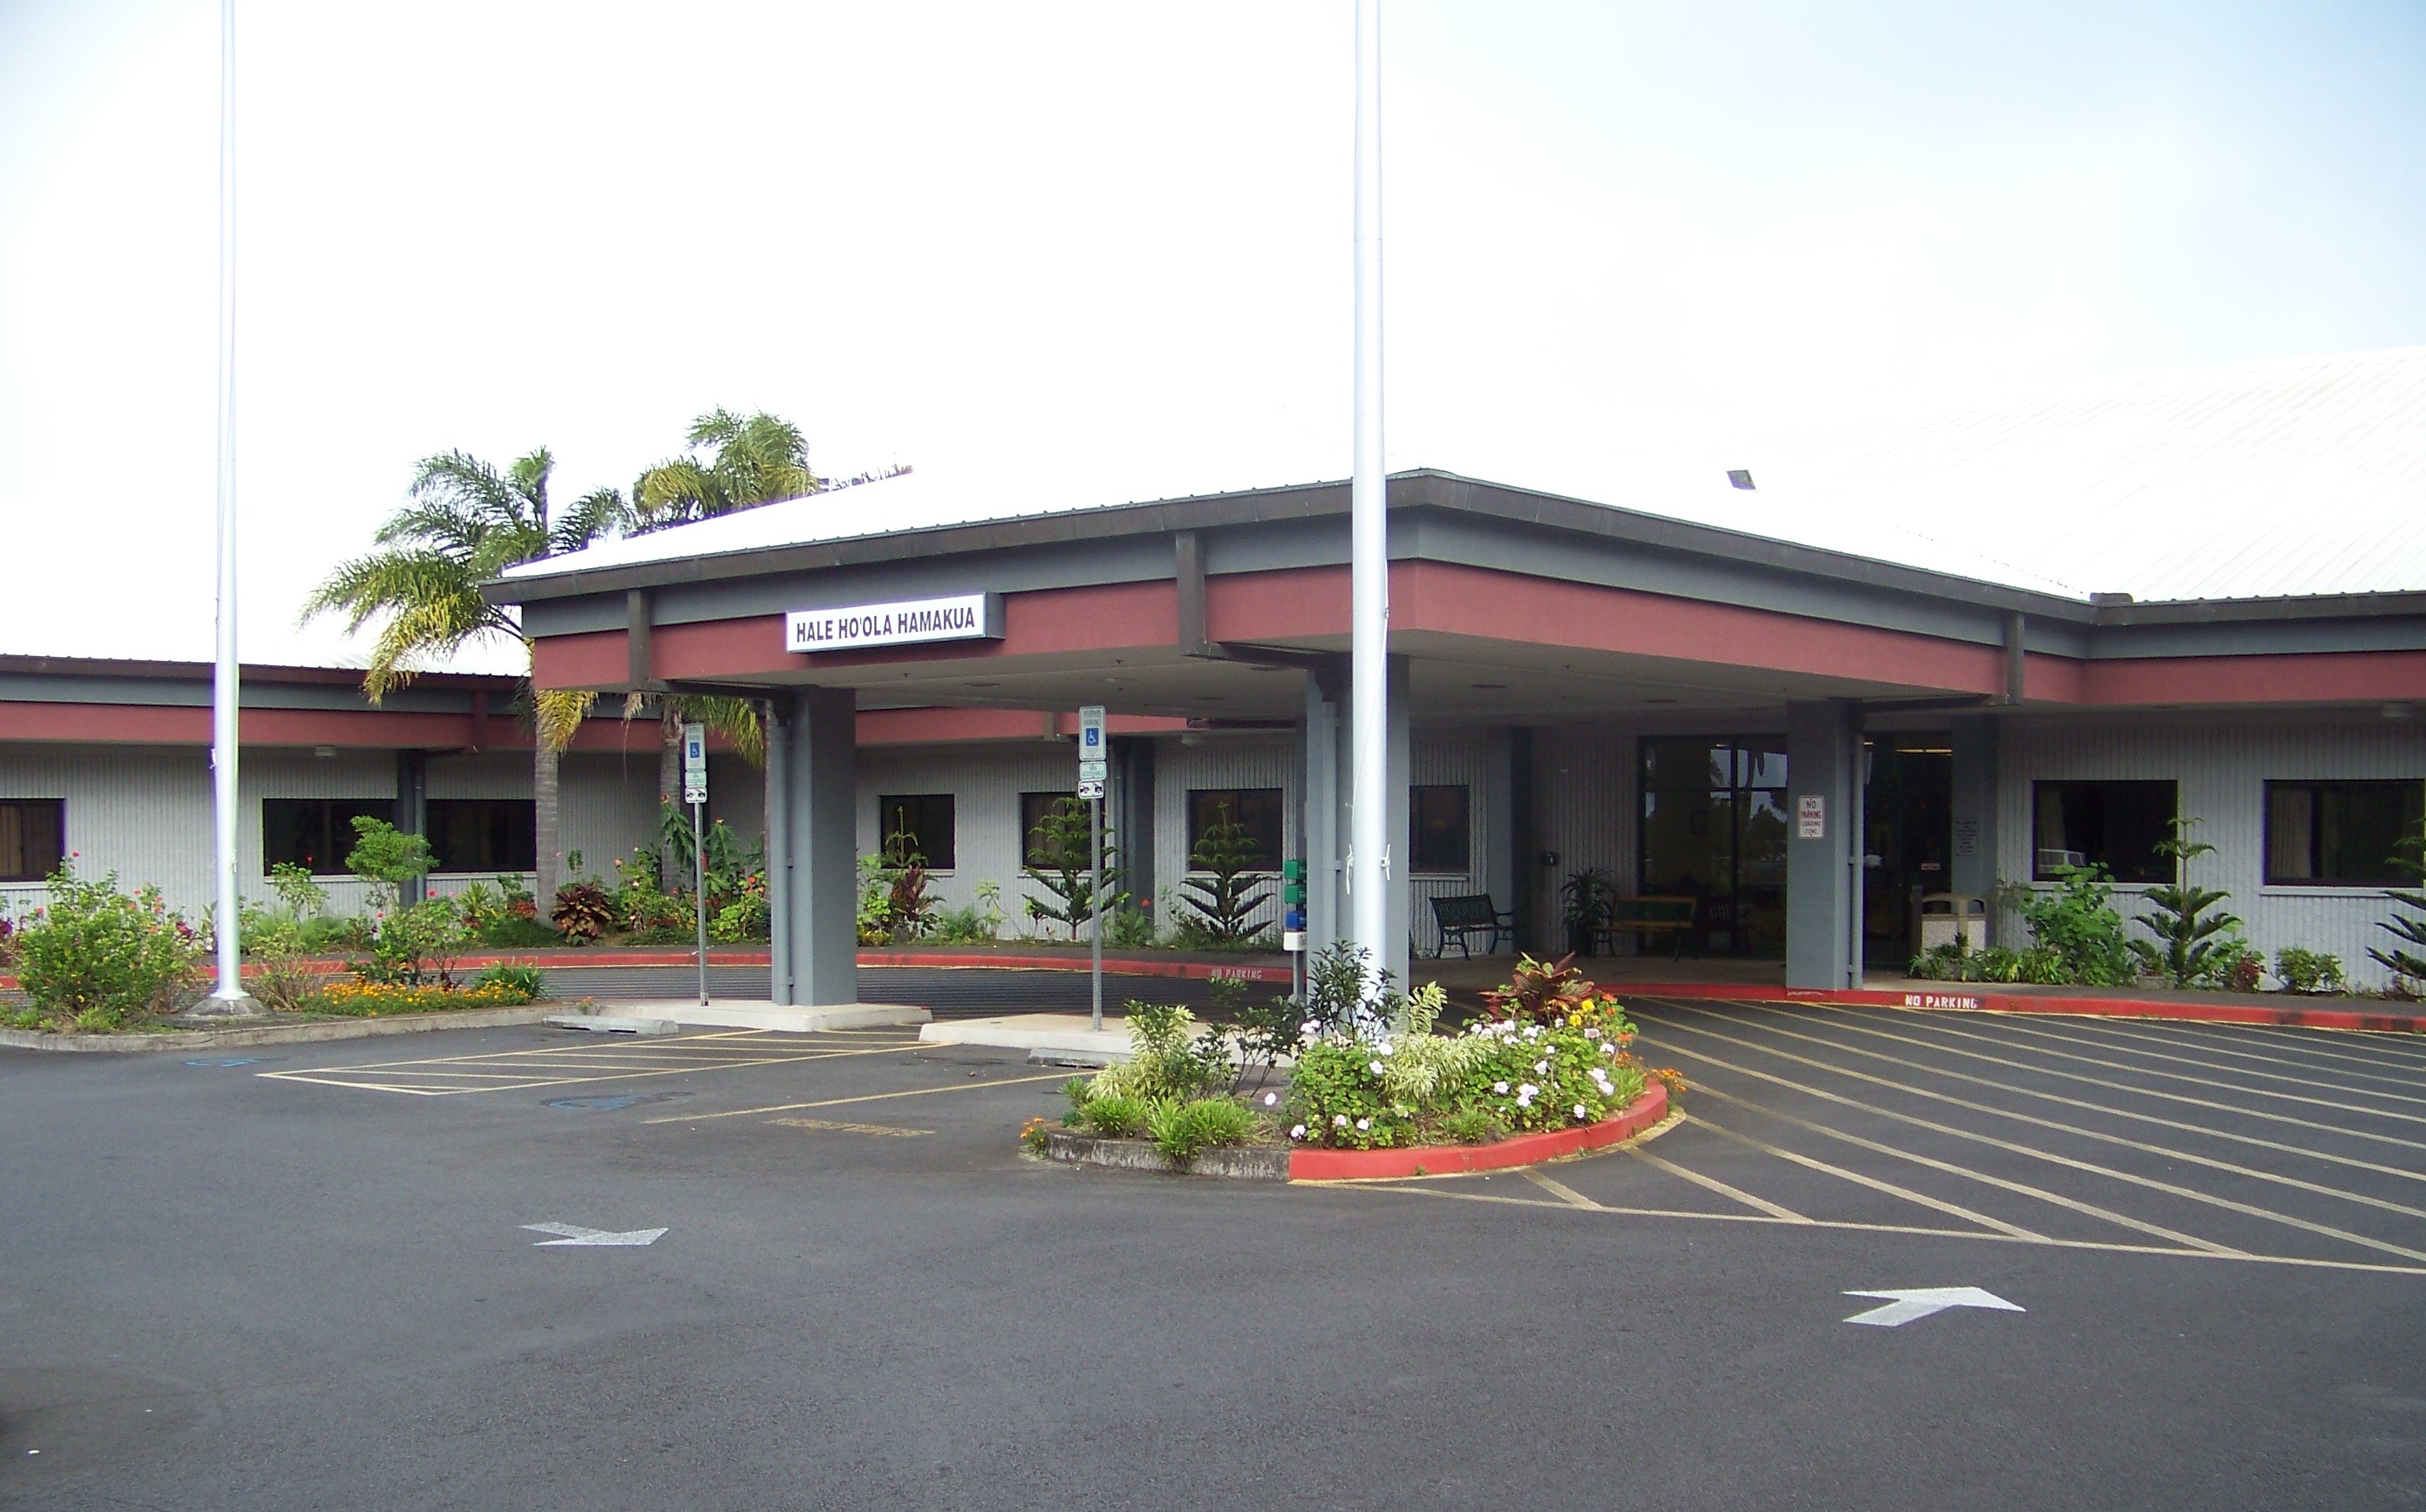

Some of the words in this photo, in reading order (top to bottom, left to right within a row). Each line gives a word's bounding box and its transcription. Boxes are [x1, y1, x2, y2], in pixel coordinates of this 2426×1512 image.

[796, 620, 834, 643] HALE
[839, 615, 893, 639] HO'OLA
[898, 607, 975, 634] HAMAKUA
[1806, 800, 1816, 809] NO
[1801, 810, 1821, 819] PARKING
[1211, 969, 1222, 977] NO
[1226, 969, 1262, 979] PARKING
[1905, 994, 1921, 1006] NO
[1926, 996, 1978, 1009] PARKING
